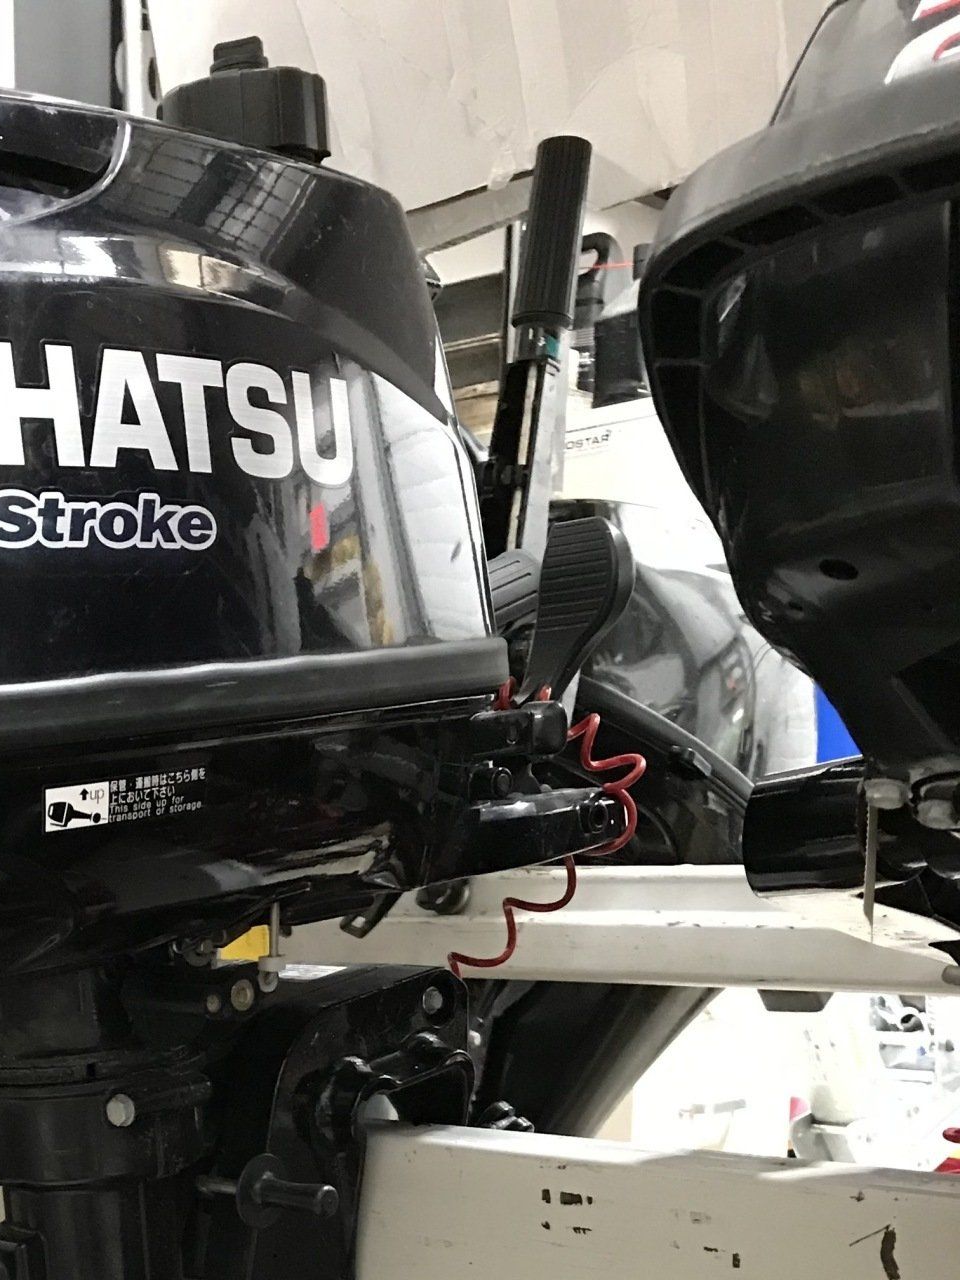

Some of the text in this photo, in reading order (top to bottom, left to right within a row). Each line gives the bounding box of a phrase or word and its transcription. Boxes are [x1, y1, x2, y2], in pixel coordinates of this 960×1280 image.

[90, 788, 105, 804] up
[109, 795, 185, 814] This side up for
[109, 809, 151, 823] transport
[155, 808, 165, 816] or
